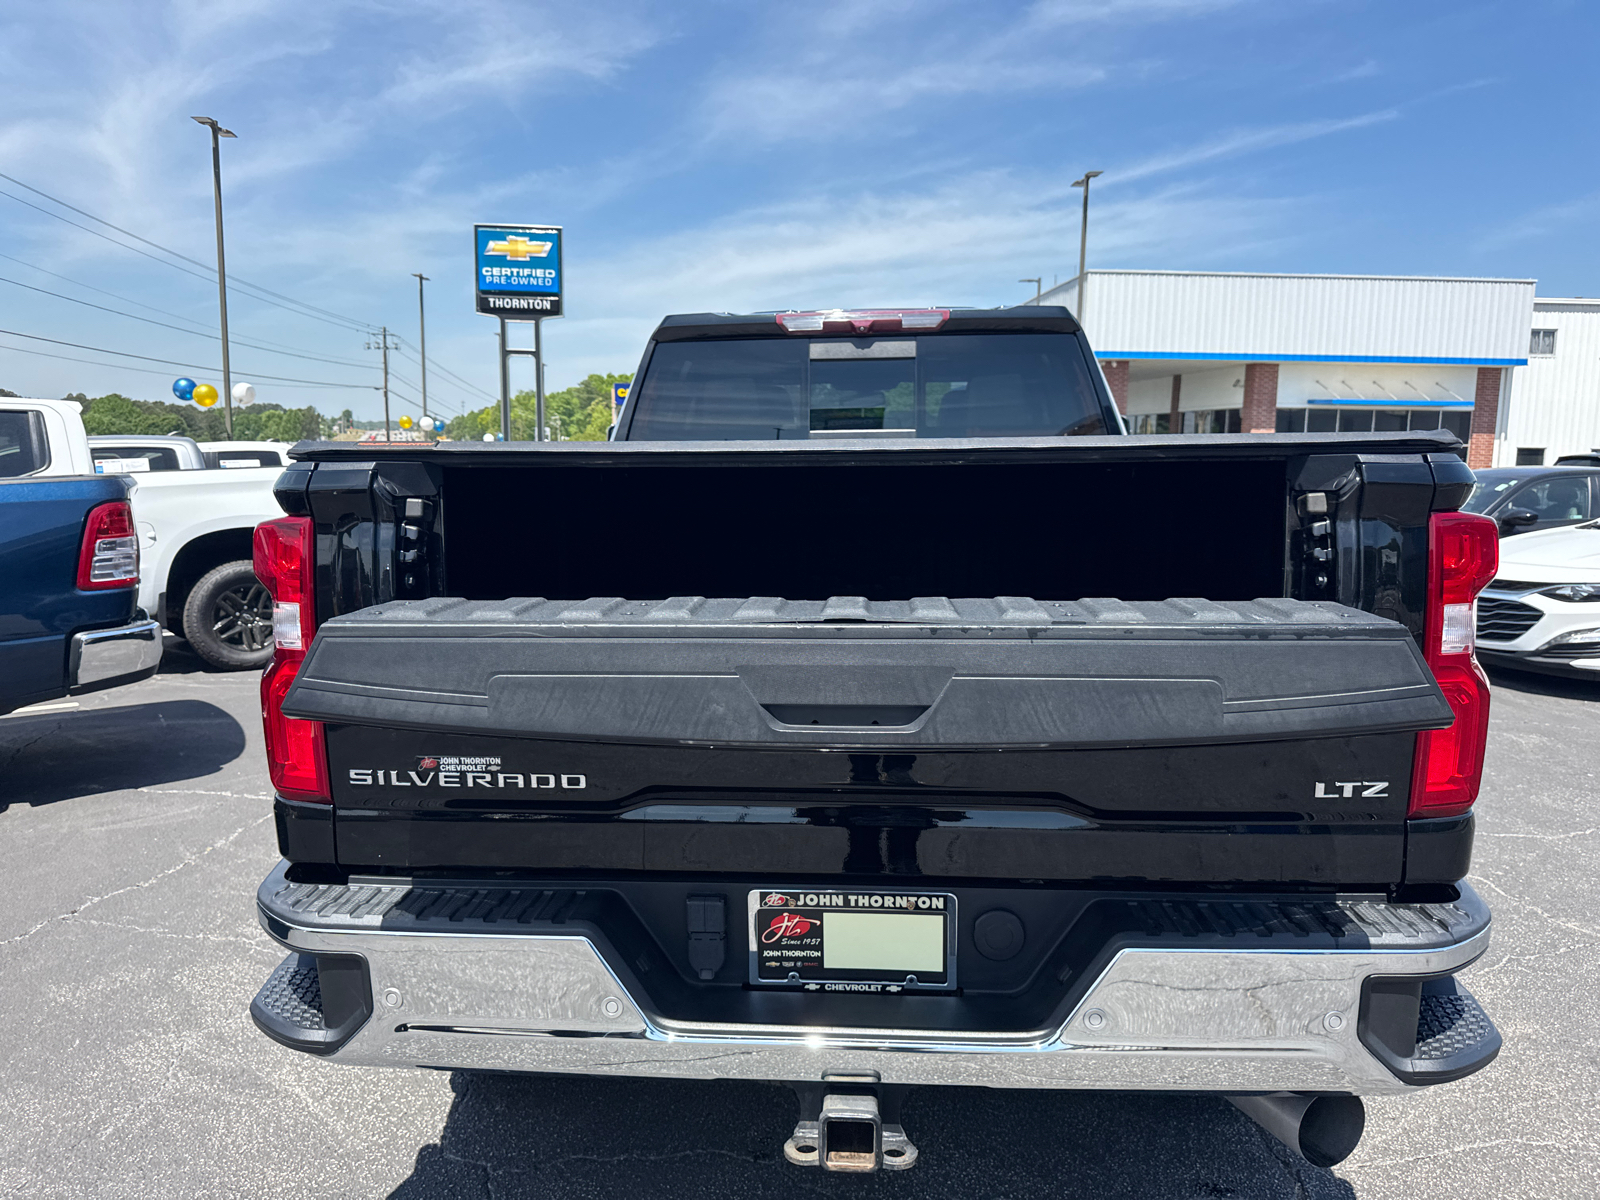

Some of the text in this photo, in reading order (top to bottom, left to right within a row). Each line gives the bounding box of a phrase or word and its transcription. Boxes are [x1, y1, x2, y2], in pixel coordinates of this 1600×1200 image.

[482, 266, 556, 278] CERTIFIED
[485, 276, 553, 286] PRE-OWNED
[488, 297, 551, 310] THORNTON
[440, 757, 501, 765] JOHN THORNTON
[349, 769, 587, 789] SILVERADO
[1314, 781, 1389, 798] LTZ
[797, 894, 844, 906] JOHN
[848, 895, 944, 909] THORNTON
[781, 937, 801, 945] Since
[824, 983, 883, 992] CHEVROLET
